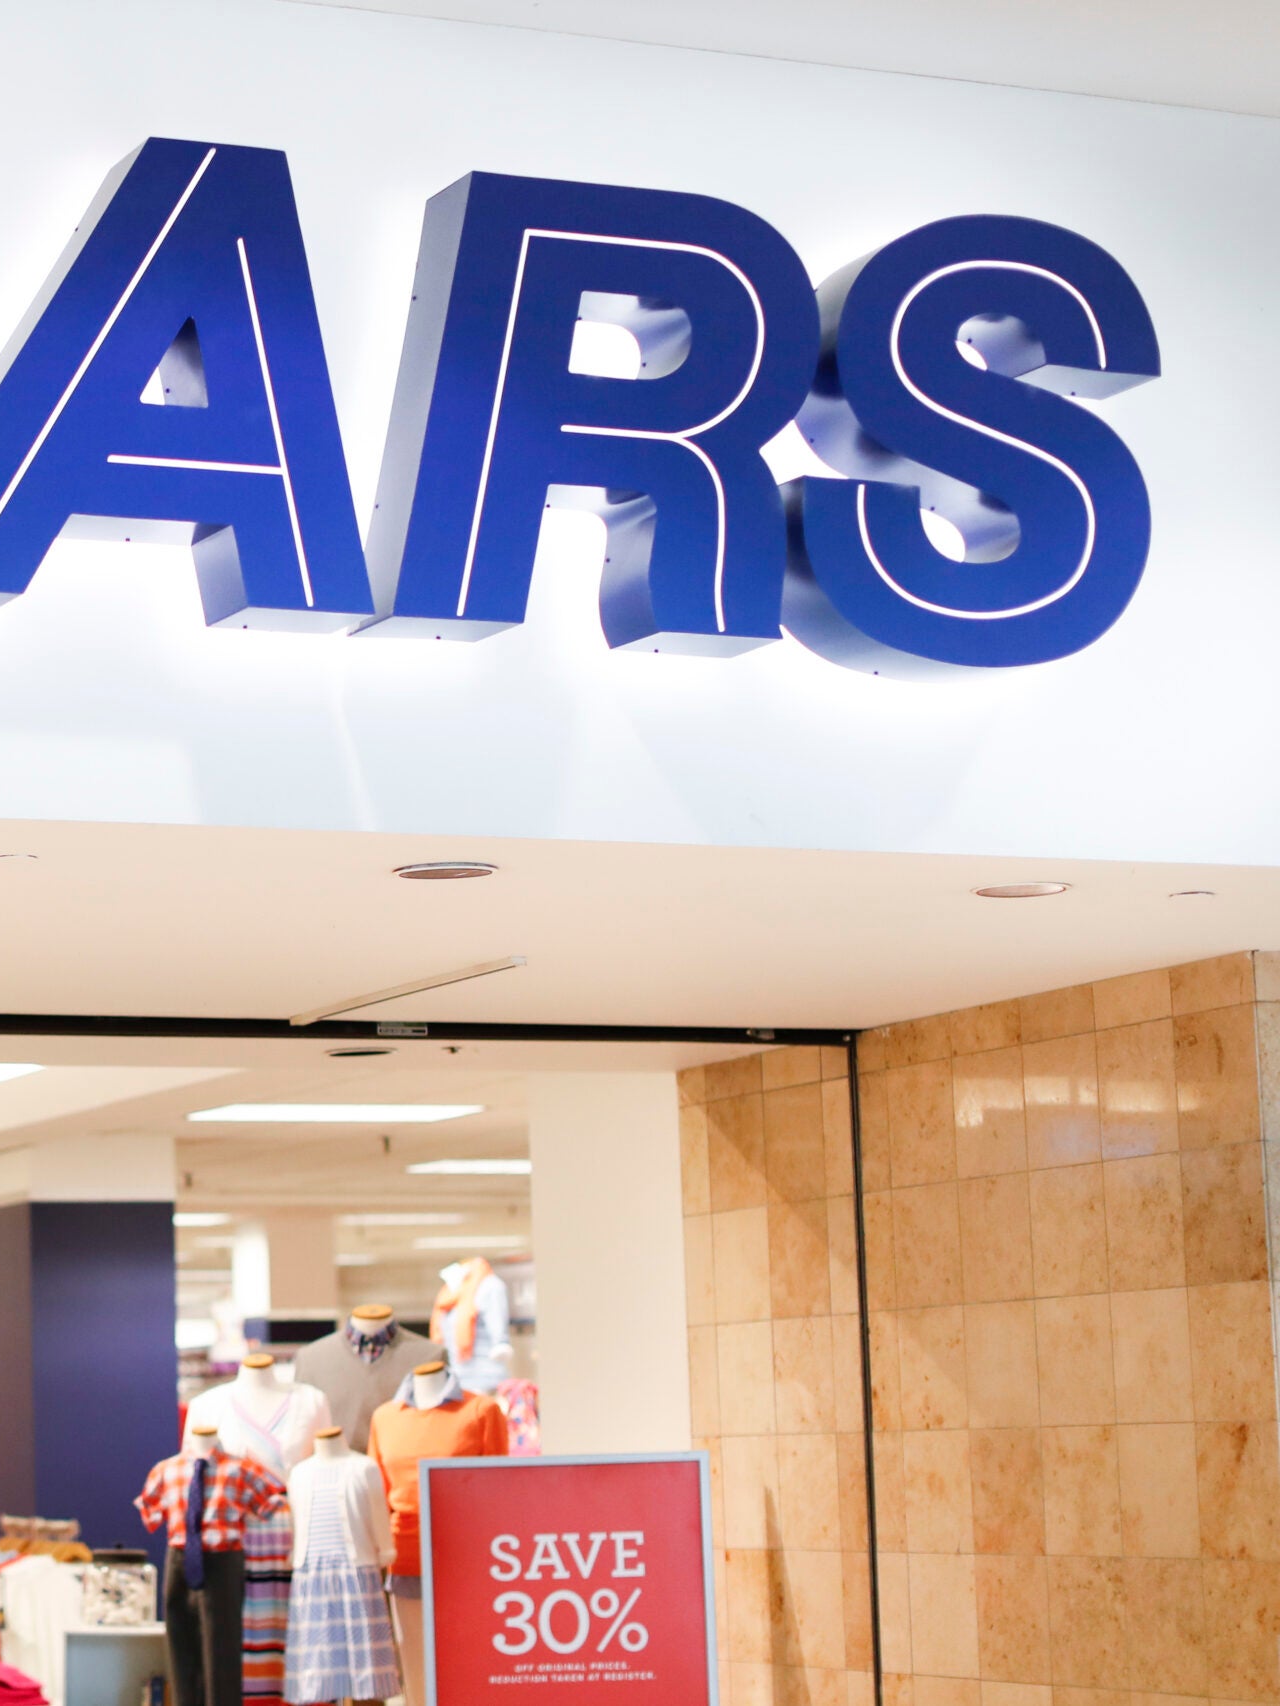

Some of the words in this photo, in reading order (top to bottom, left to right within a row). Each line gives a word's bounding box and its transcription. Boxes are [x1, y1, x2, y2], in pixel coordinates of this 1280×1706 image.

[489, 1531, 646, 1582] SAVE
[492, 1587, 650, 1656] 30%
[489, 1674, 548, 1684] REDUCTION
[551, 1673, 585, 1682] TAKEN
[587, 1672, 600, 1682] AT
[514, 1663, 534, 1673] OFF
[537, 1662, 586, 1673] ORIGINAL
